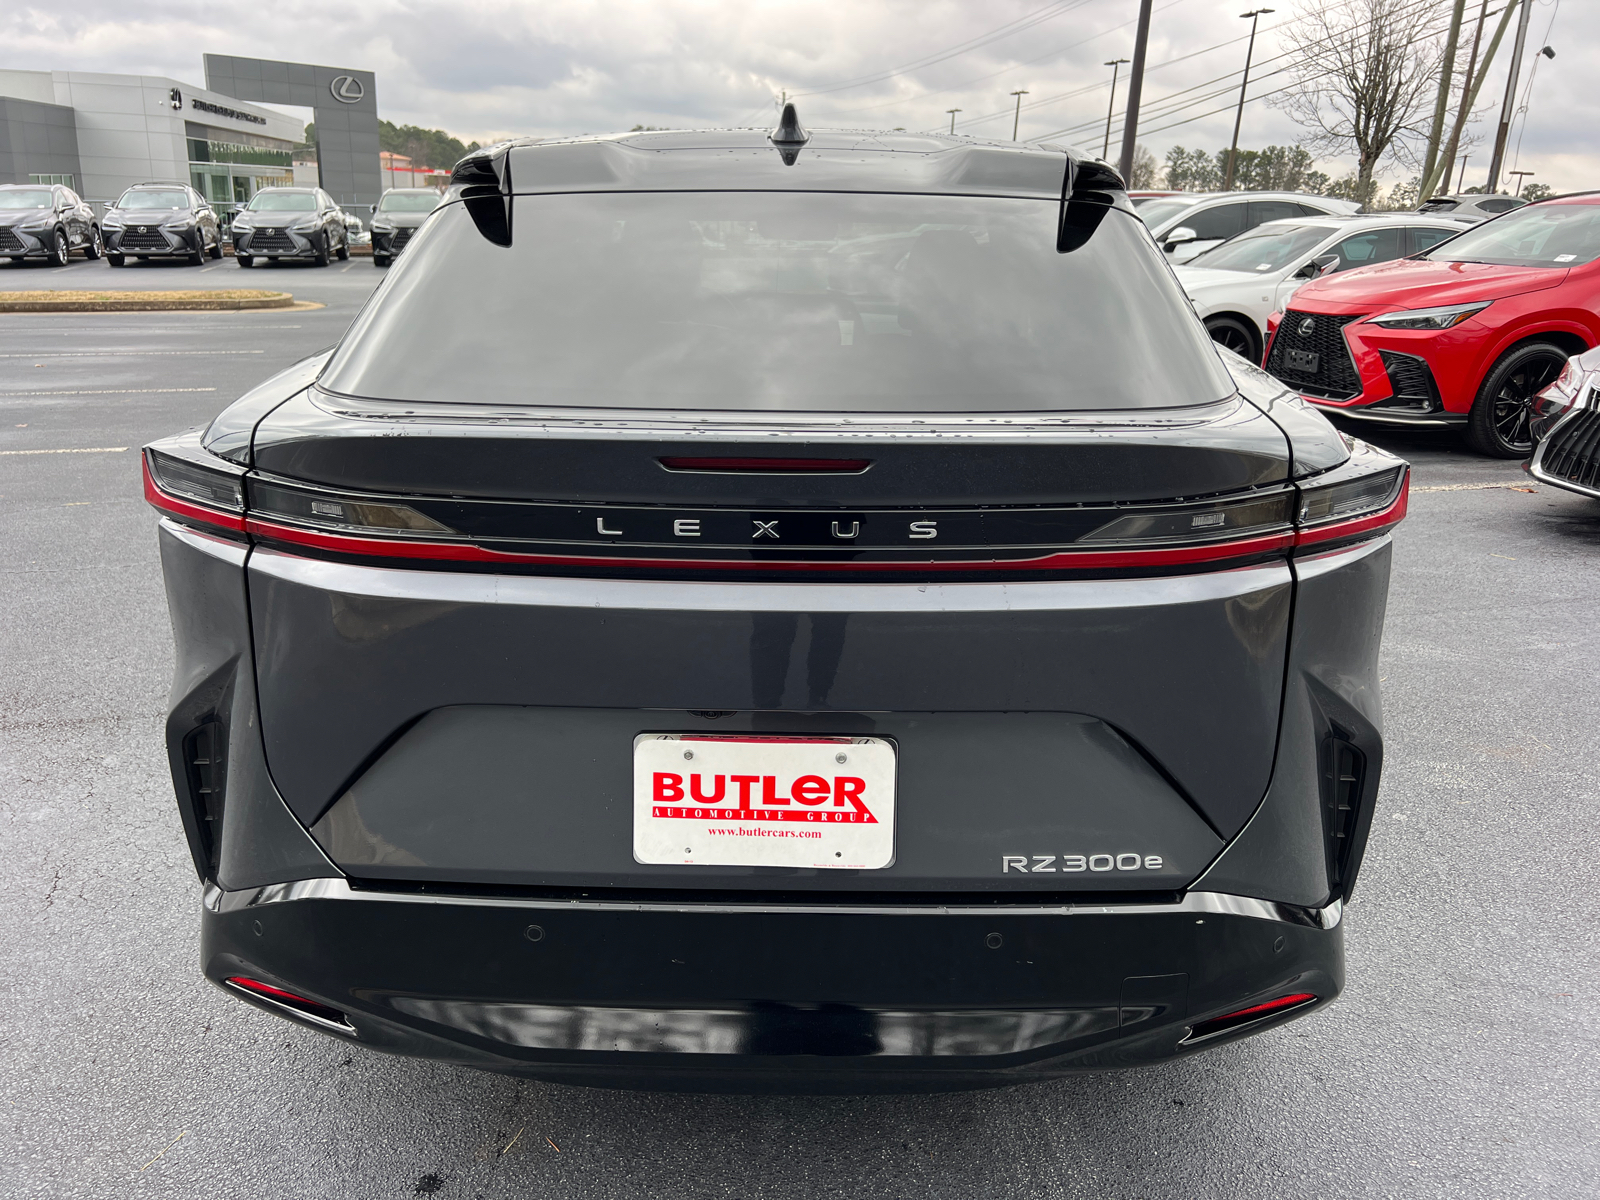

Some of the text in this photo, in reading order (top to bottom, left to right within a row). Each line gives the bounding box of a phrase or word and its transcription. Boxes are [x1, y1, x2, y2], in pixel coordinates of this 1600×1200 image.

[596, 517, 938, 540] LEXUS
[653, 808, 871, 822] AUTOMOTIVE GROUP
[707, 827, 822, 839] www.butlercars.com
[1002, 853, 1163, 874] RZ 300e
